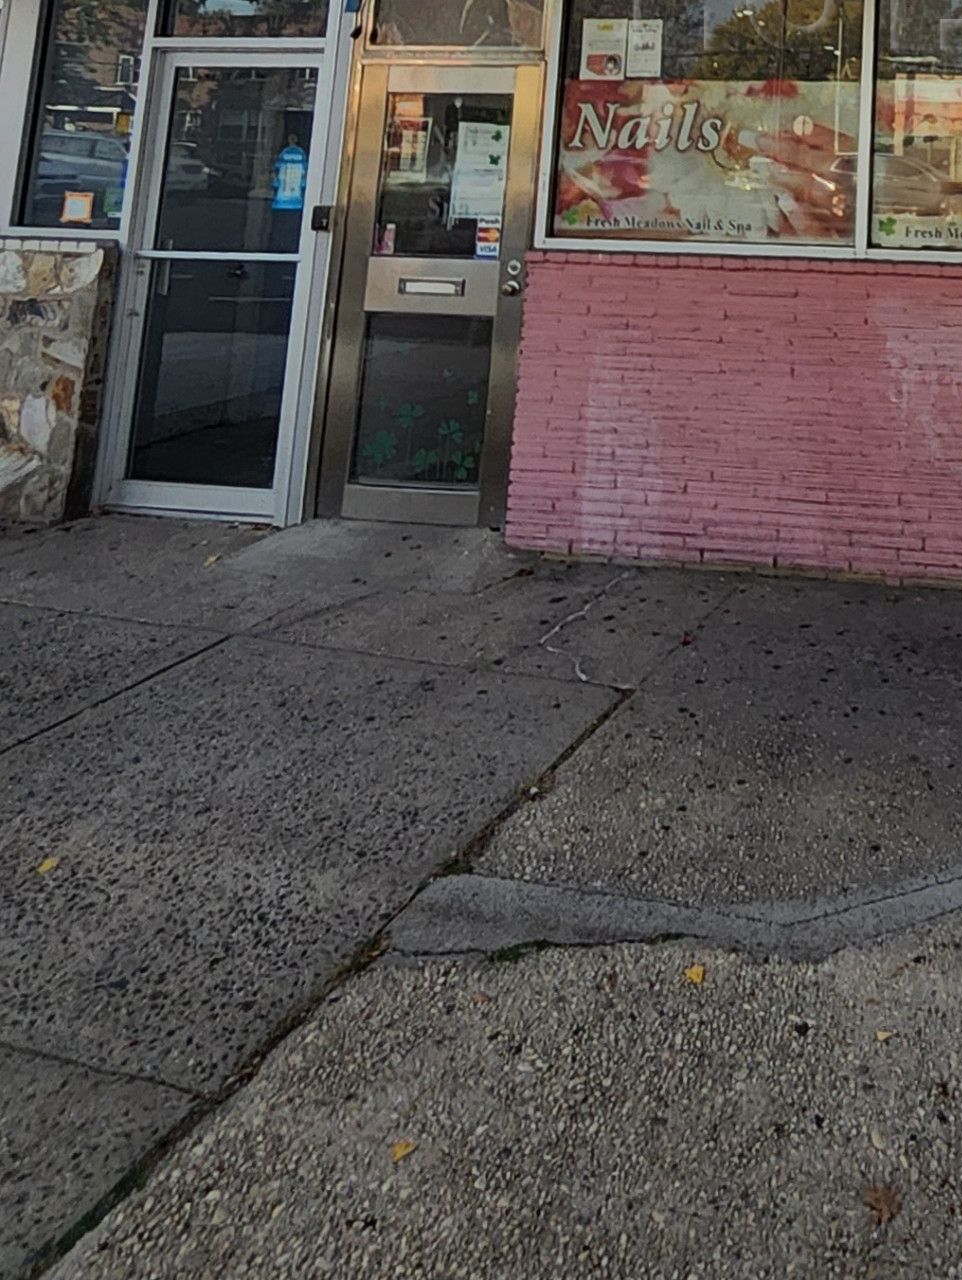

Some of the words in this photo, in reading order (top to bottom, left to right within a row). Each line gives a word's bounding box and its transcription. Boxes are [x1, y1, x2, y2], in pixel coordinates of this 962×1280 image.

[568, 102, 722, 151] Nails
[728, 219, 752, 233] Spa
[905, 226, 940, 238] Fresh
